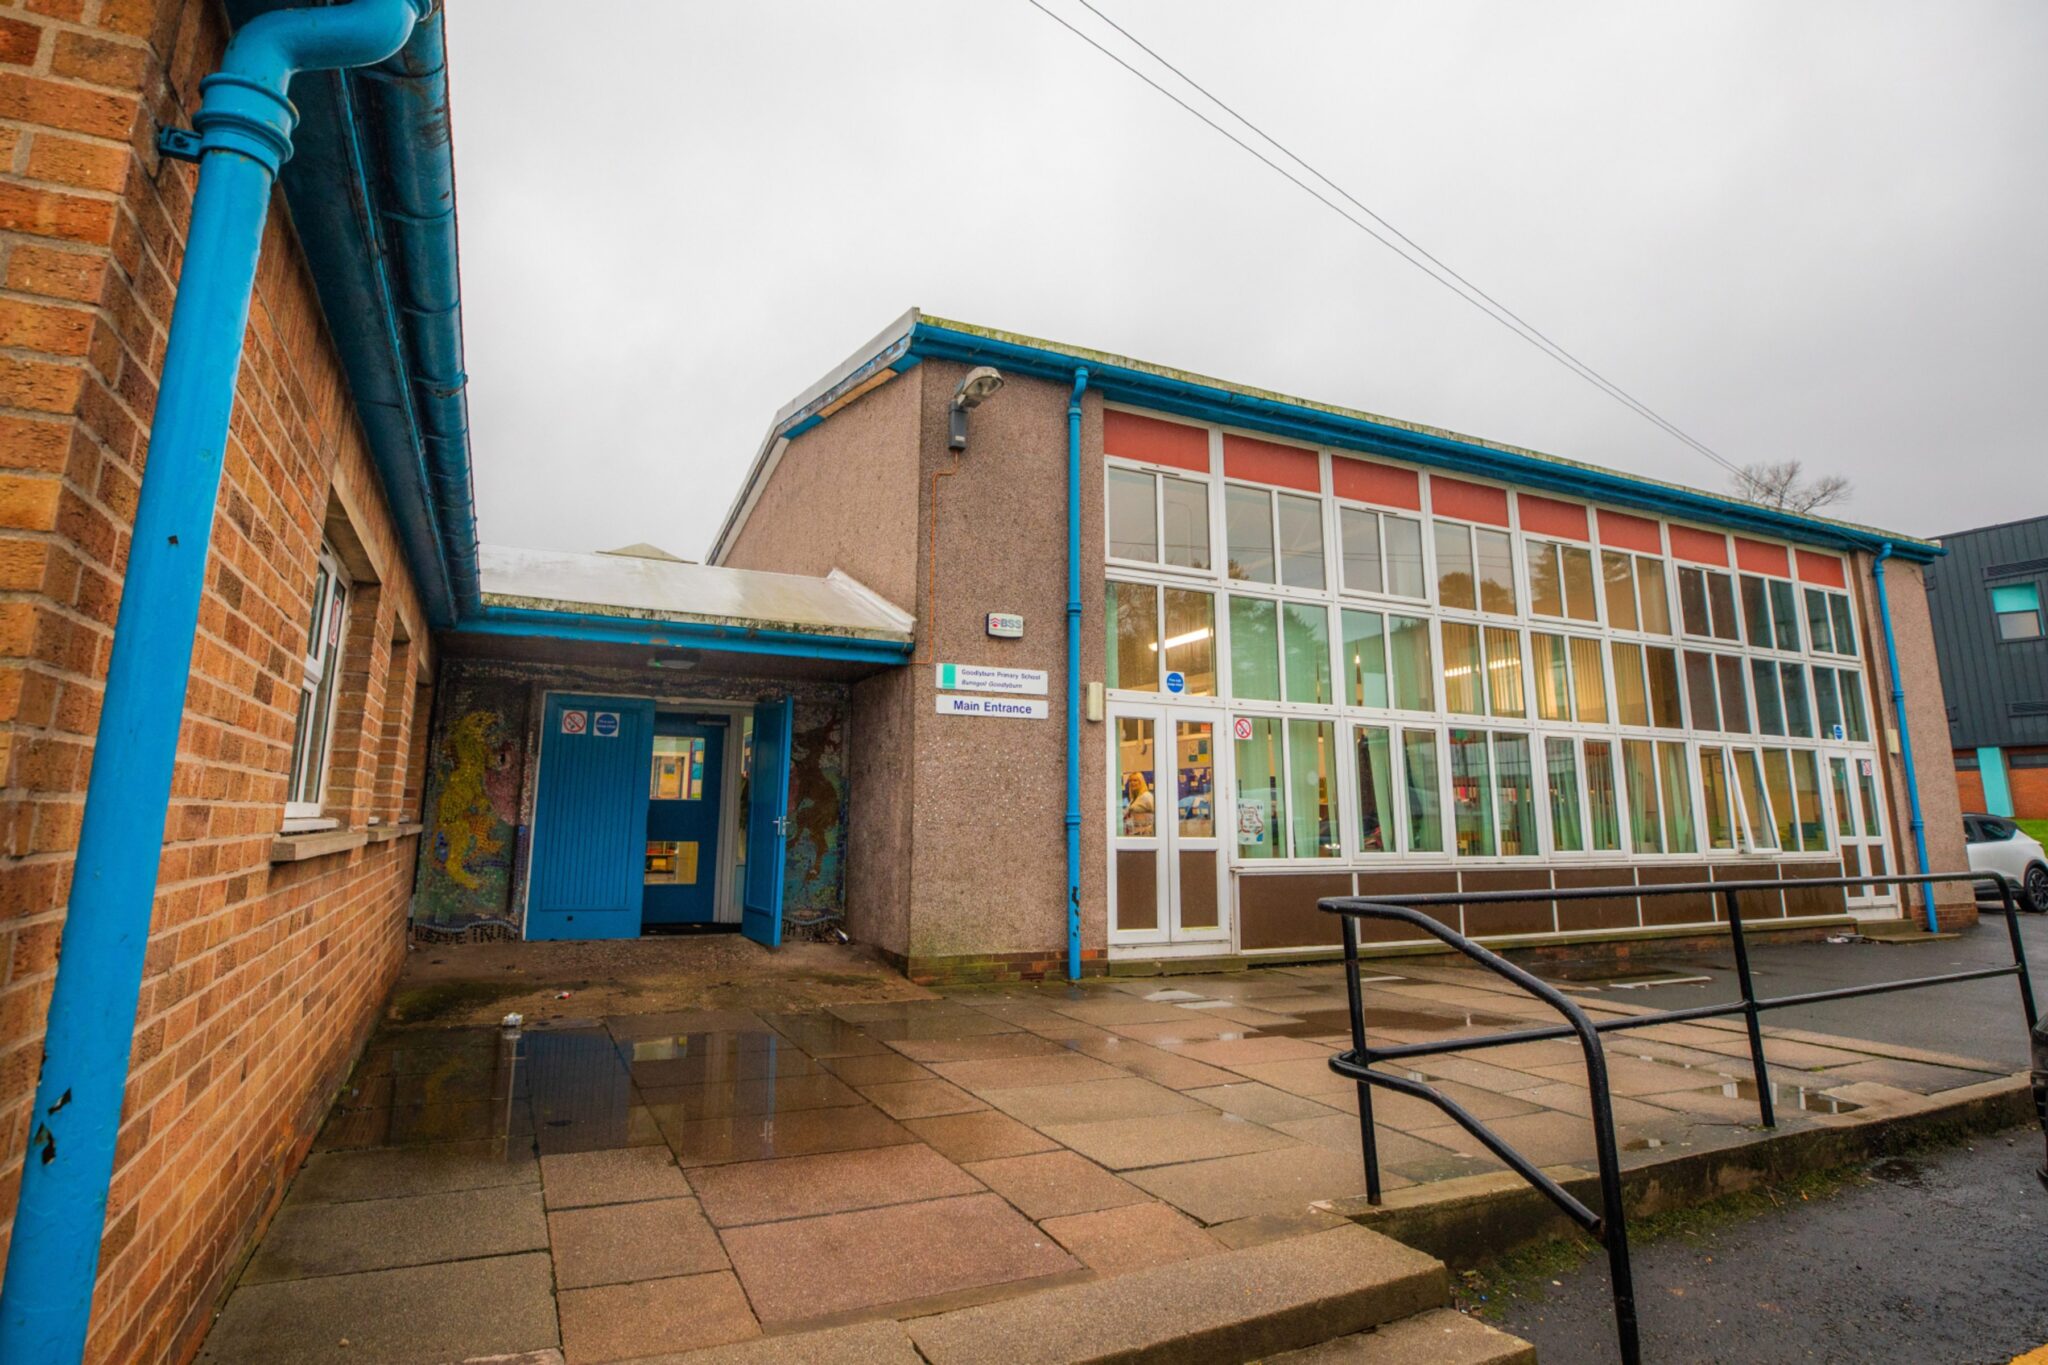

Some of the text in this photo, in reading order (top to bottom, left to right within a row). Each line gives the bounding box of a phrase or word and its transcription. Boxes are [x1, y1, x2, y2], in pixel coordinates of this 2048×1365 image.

[1001, 618, 1022, 629] BSS
[997, 671, 1019, 680] Primary
[953, 700, 1032, 714] Main Entrance
